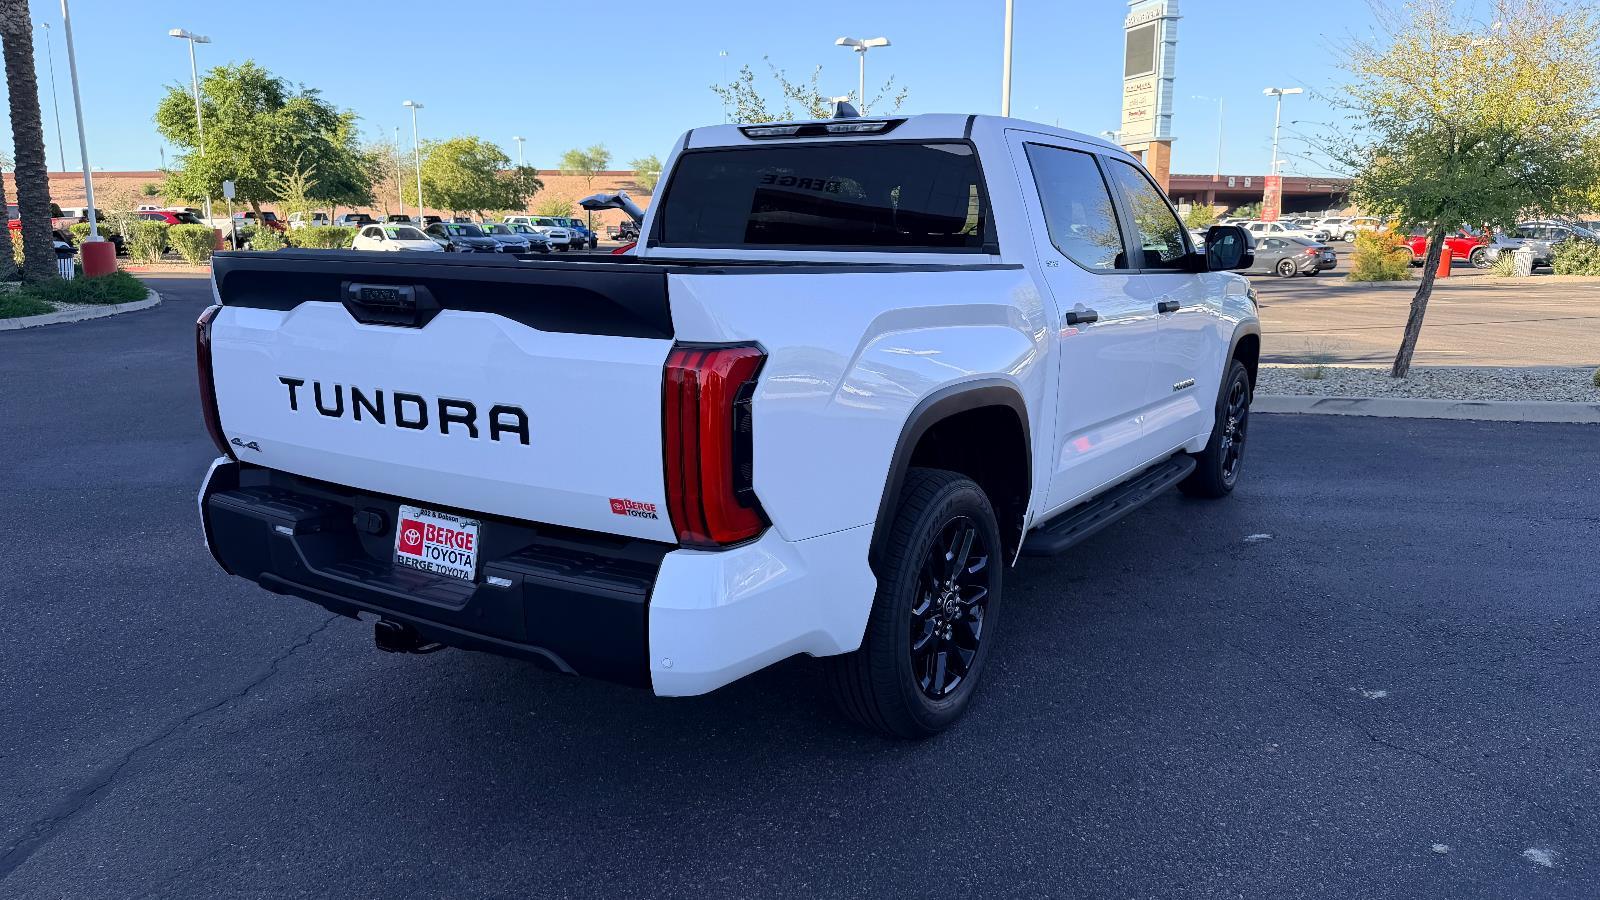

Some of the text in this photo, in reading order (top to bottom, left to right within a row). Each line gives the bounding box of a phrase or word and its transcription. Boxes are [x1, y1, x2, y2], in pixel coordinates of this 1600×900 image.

[278, 376, 530, 445] TUNDRA
[625, 500, 656, 512] BERGE
[627, 510, 658, 520] TOYOTA
[425, 523, 473, 551] BERGE
[397, 555, 469, 580] BERGE TOYOTA
[425, 545, 473, 568] TOYOTA
